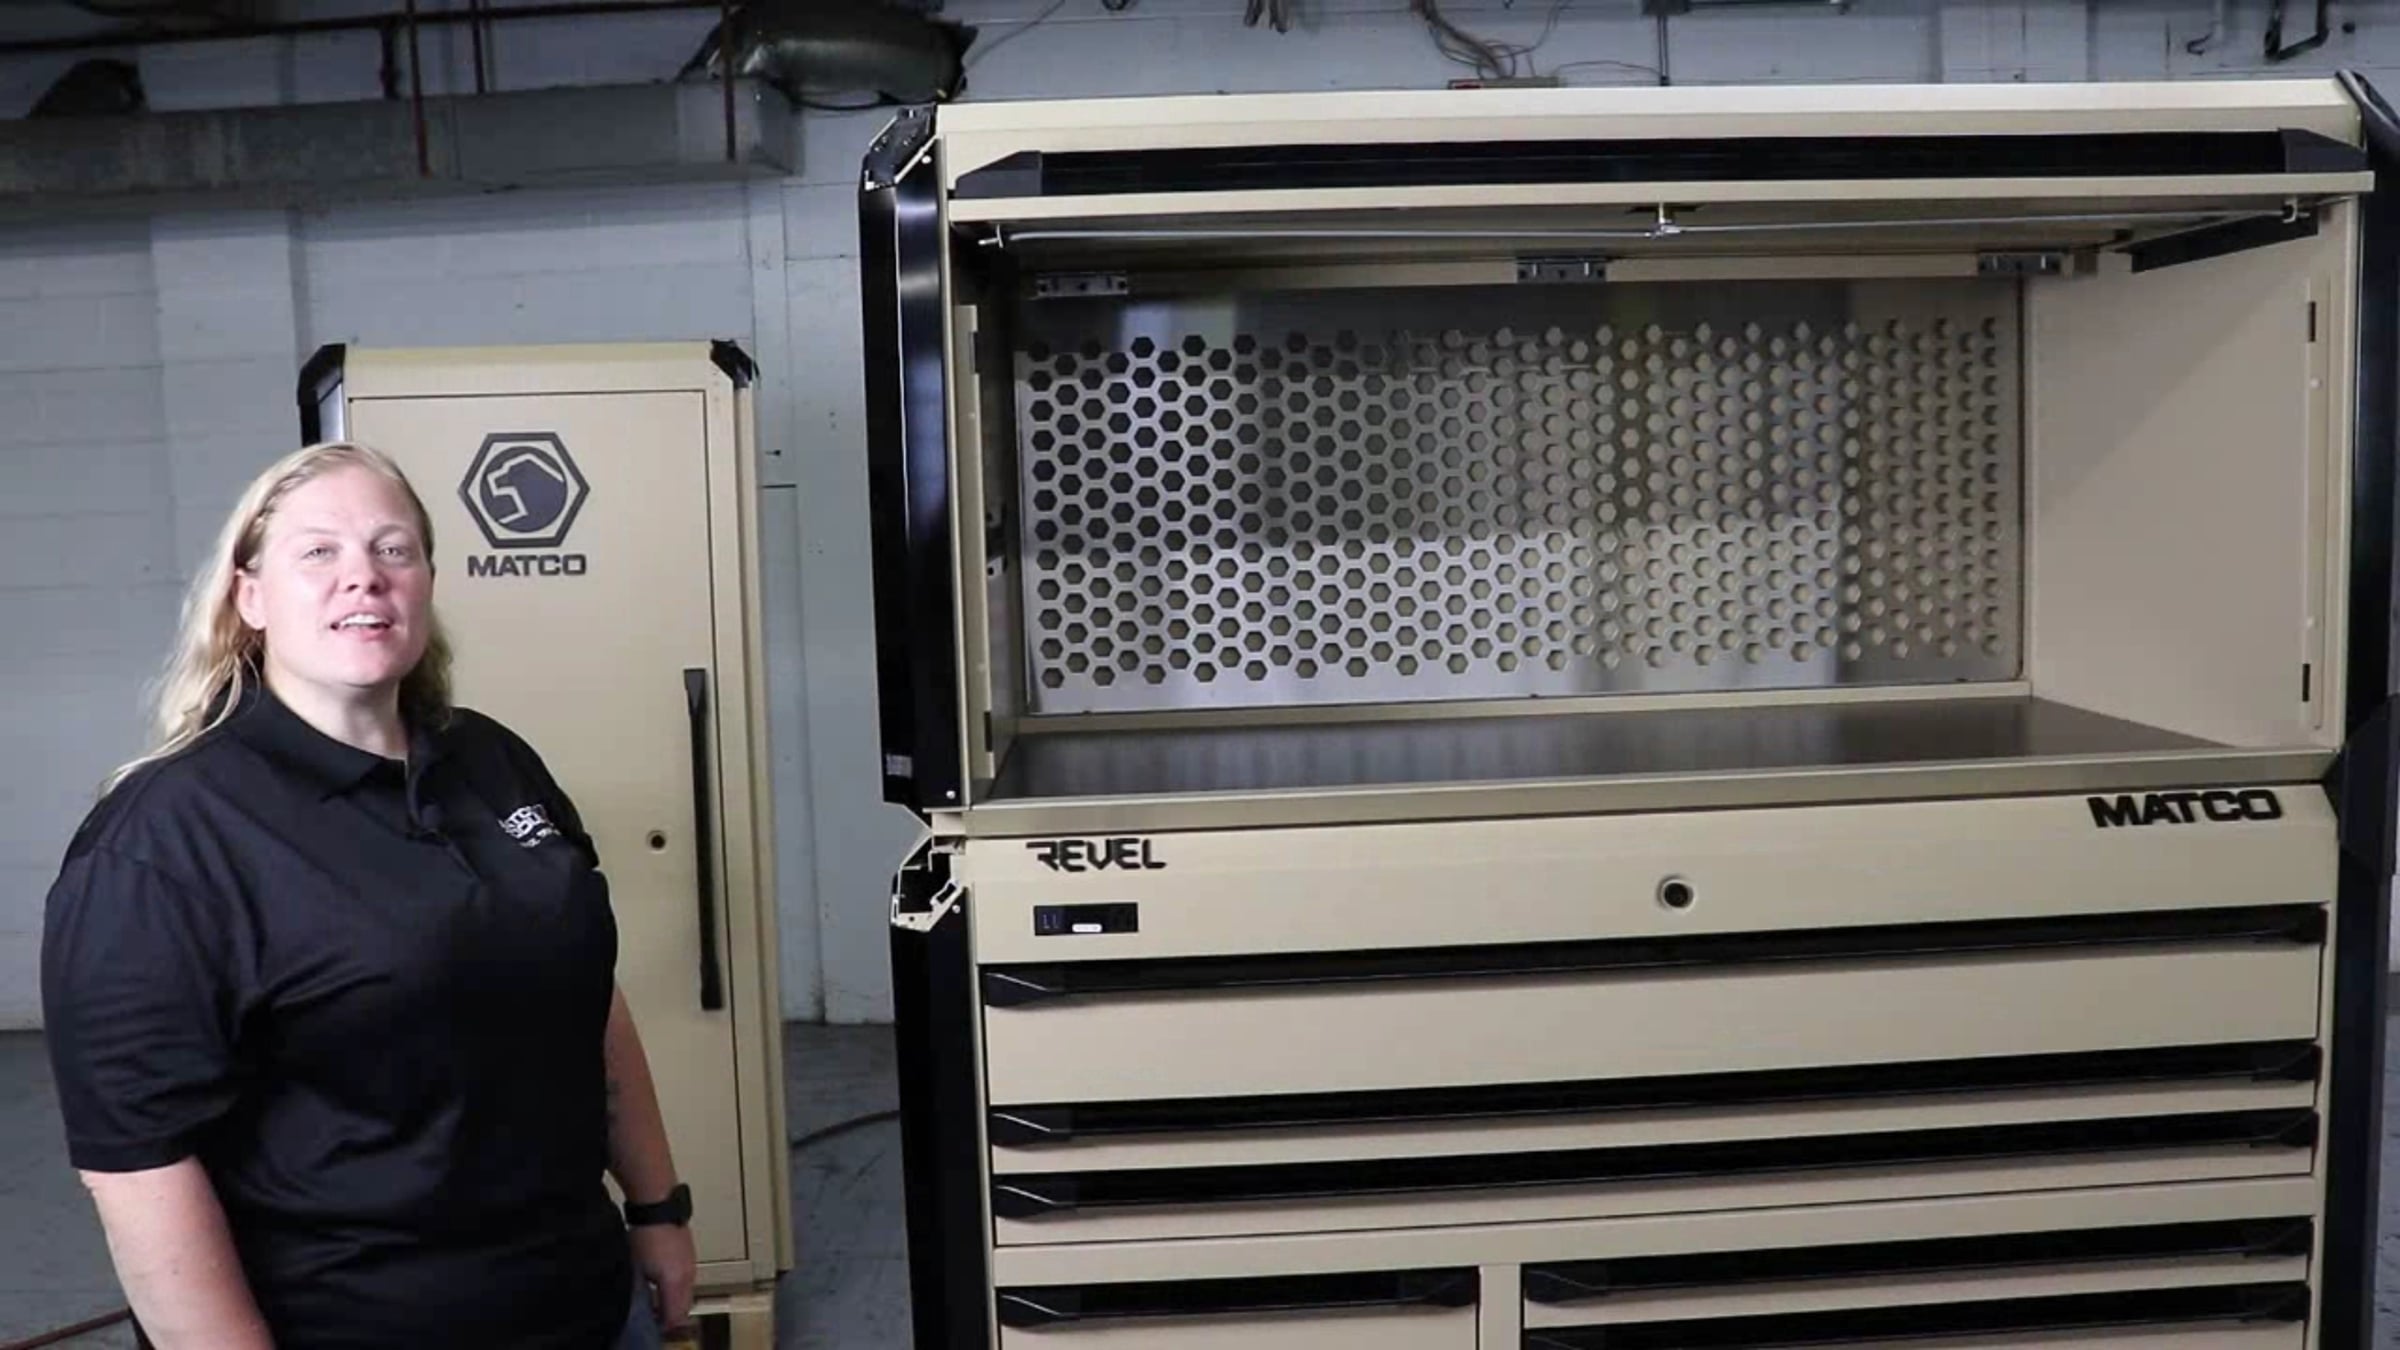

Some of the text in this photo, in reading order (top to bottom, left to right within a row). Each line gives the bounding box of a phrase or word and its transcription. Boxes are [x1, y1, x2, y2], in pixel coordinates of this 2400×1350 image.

[467, 554, 587, 577] MATCO
[2087, 789, 2283, 828] MATCO
[1026, 838, 1167, 872] REVEL
